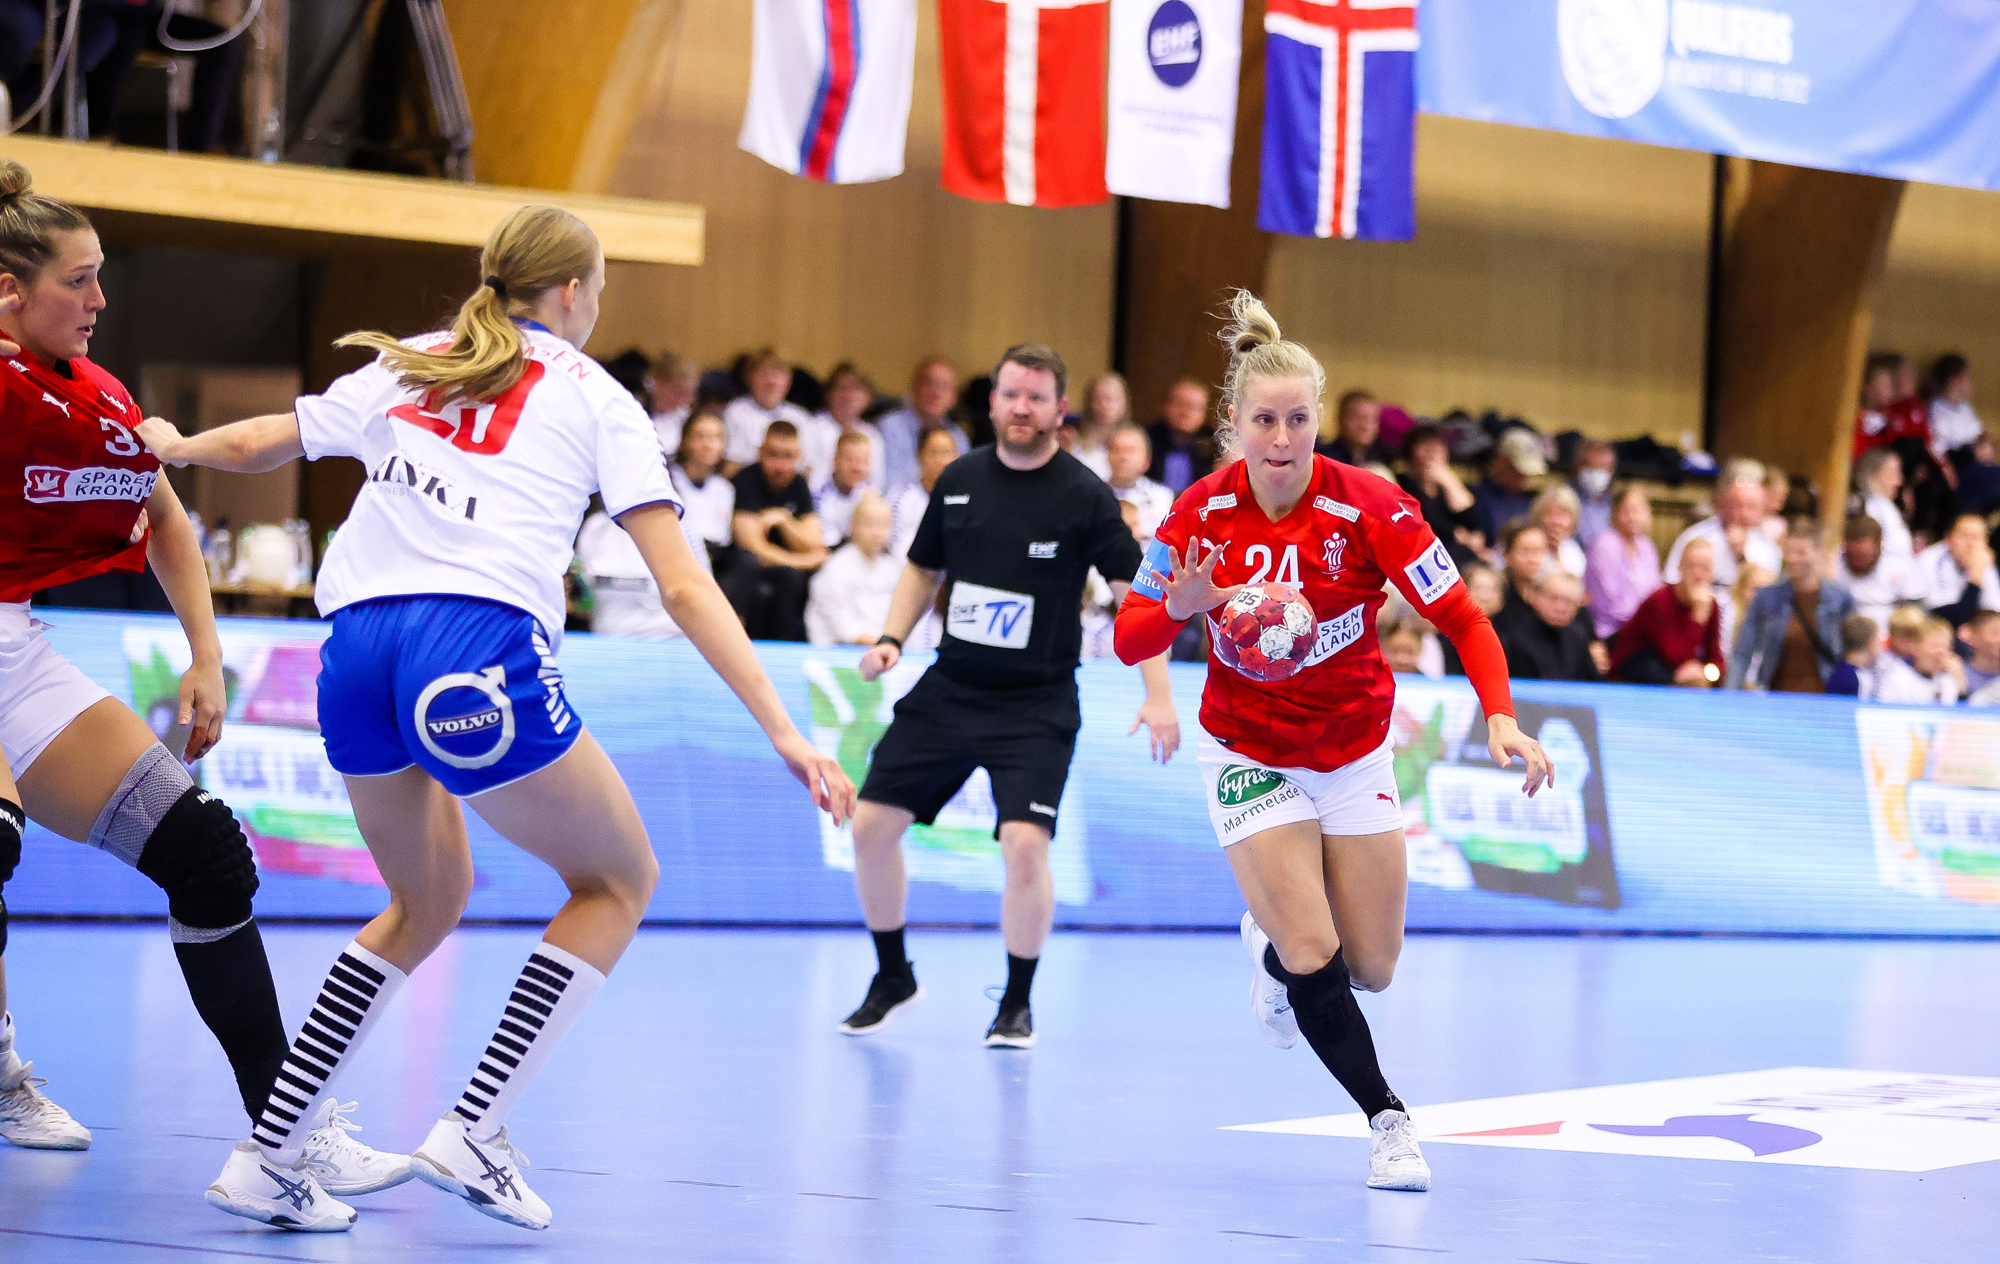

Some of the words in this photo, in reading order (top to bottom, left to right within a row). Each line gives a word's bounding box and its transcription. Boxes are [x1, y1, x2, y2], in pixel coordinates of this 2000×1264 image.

[1244, 543, 1304, 594] 24
[985, 600, 1026, 640] TV
[428, 711, 500, 734] VOLVO
[1223, 786, 1300, 835] Marmelade
